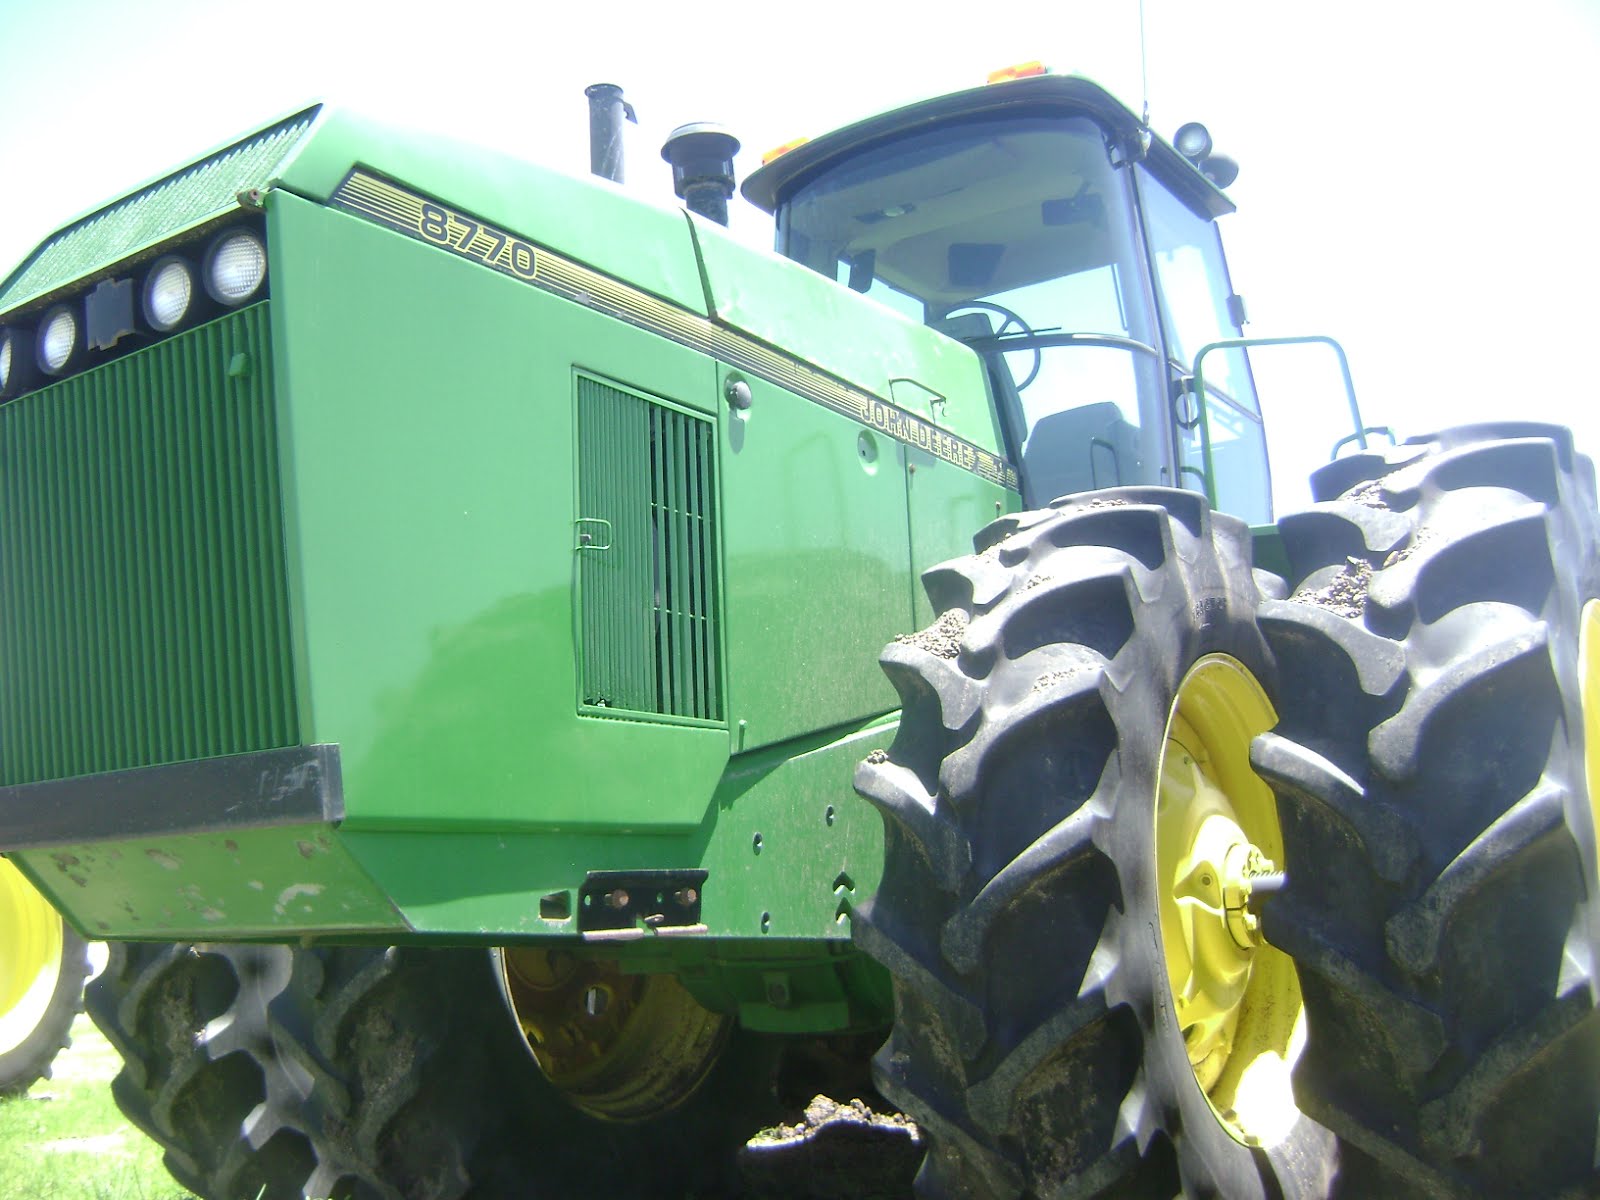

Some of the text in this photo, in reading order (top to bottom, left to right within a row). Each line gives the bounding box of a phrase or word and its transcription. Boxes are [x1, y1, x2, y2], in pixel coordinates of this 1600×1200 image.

[419, 203, 536, 278] 8770
[861, 397, 975, 468] JOHN DEERE
